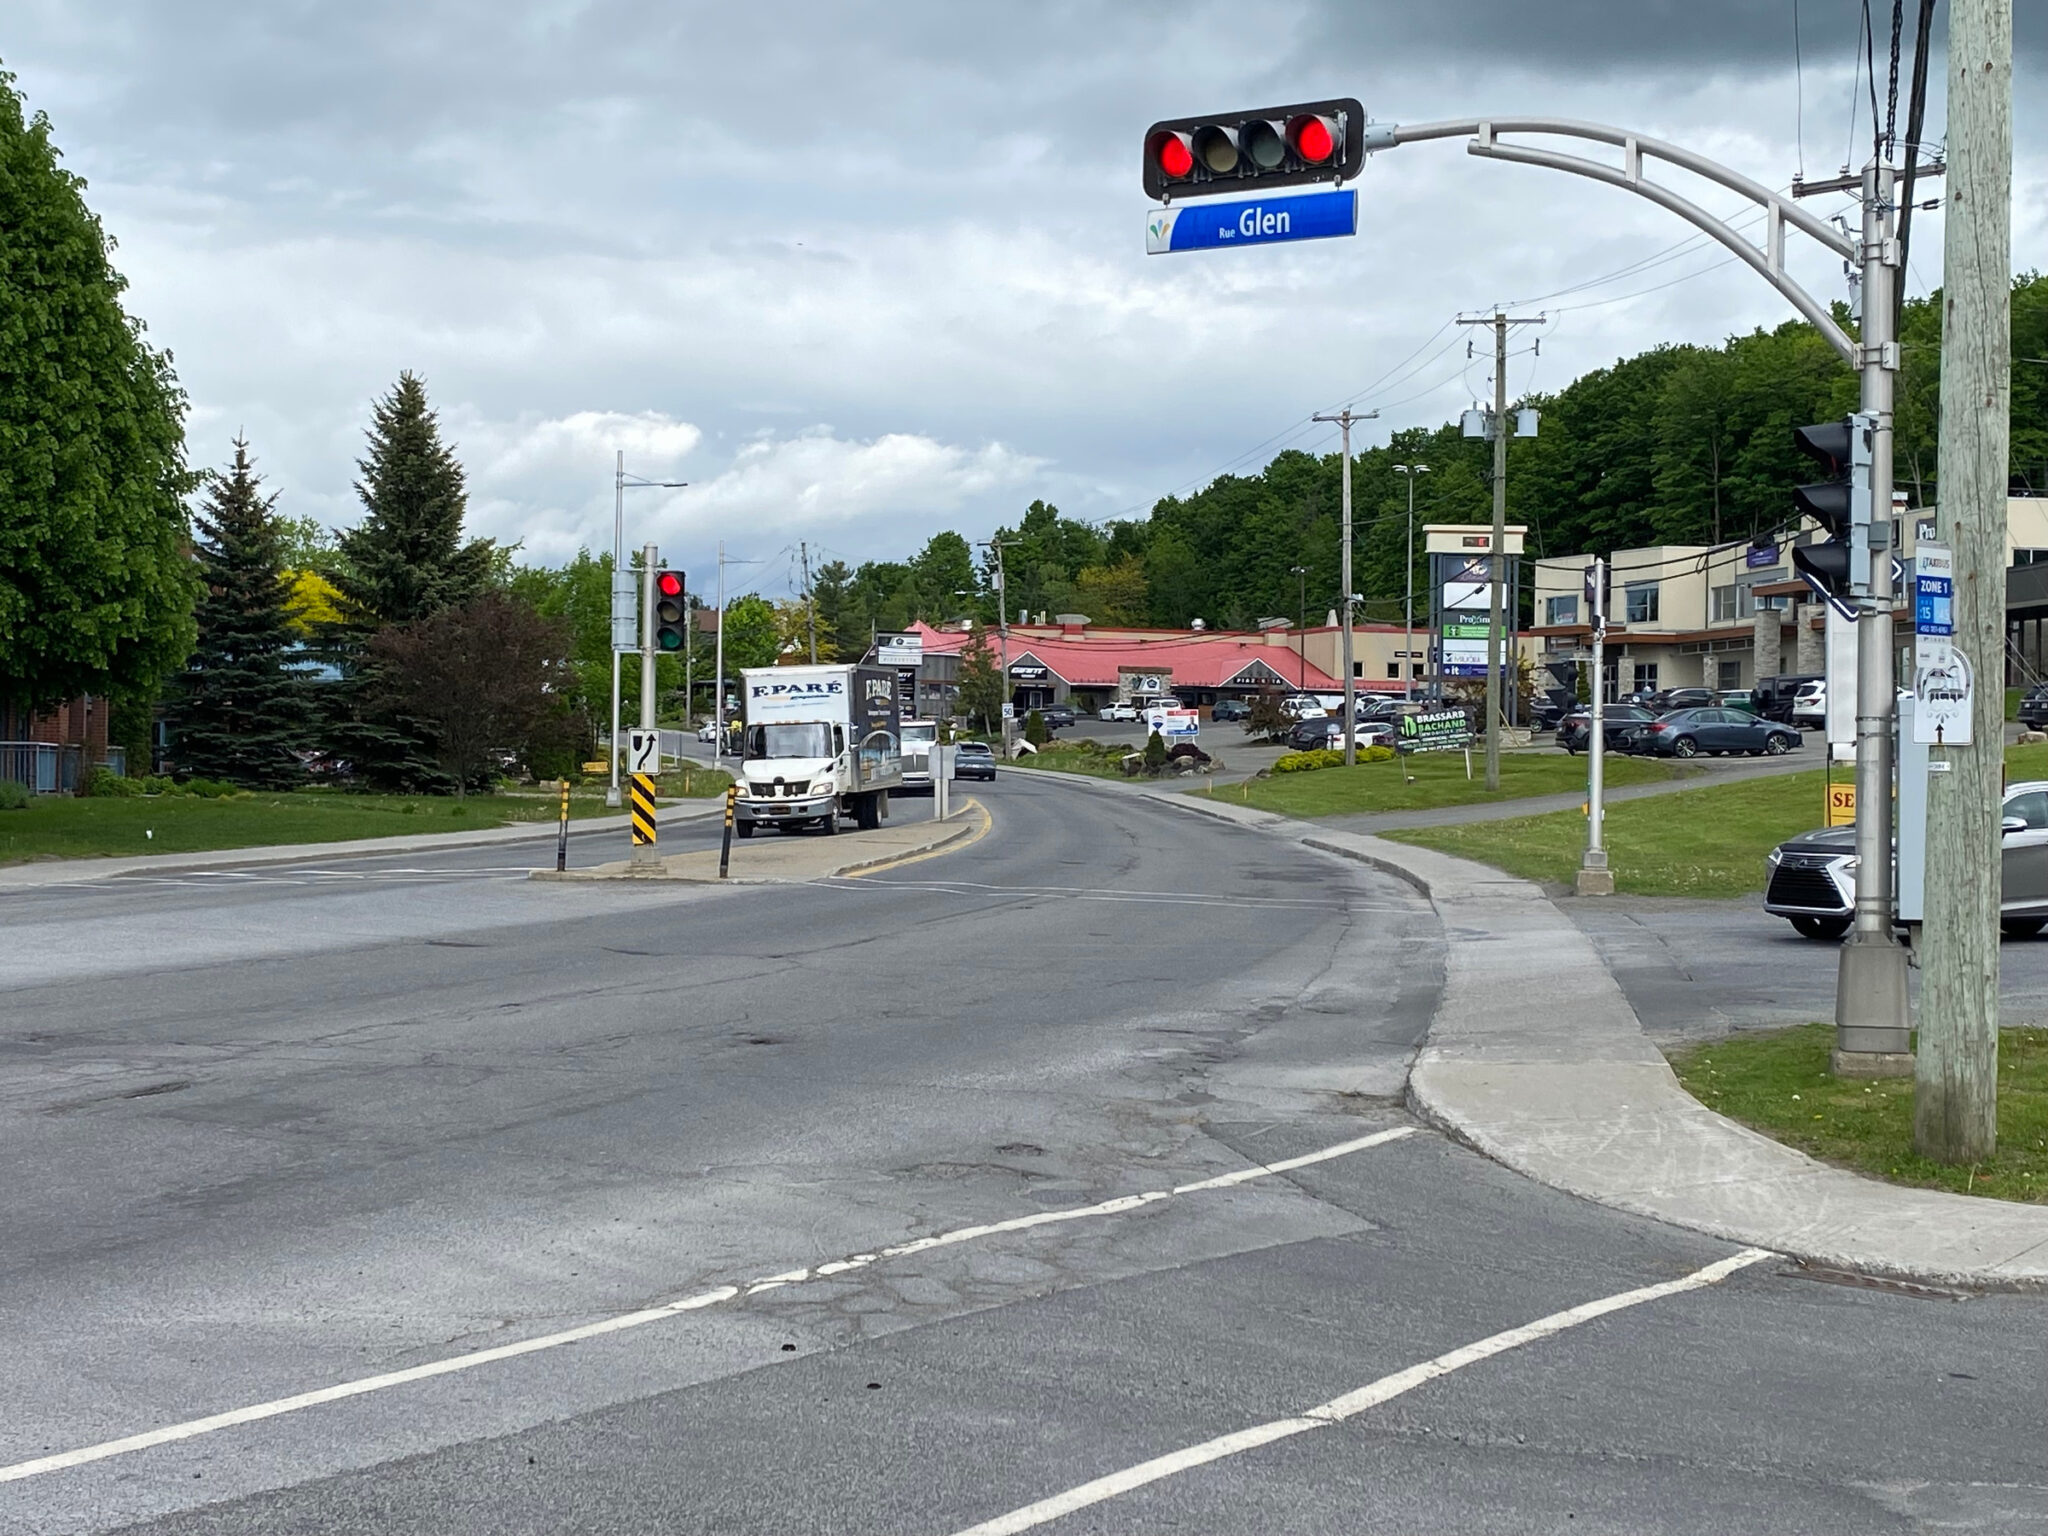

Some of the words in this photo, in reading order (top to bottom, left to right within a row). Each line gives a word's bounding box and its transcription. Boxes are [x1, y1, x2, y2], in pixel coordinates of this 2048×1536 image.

[1219, 227, 1236, 239] Rue
[1239, 206, 1291, 237] Glen
[1920, 580, 1942, 593] ZONE
[1943, 582, 1948, 594] 1
[1004, 708, 1012, 716] 50
[1416, 710, 1466, 724] BRASSARD
[1418, 719, 1467, 732] BACHAND
